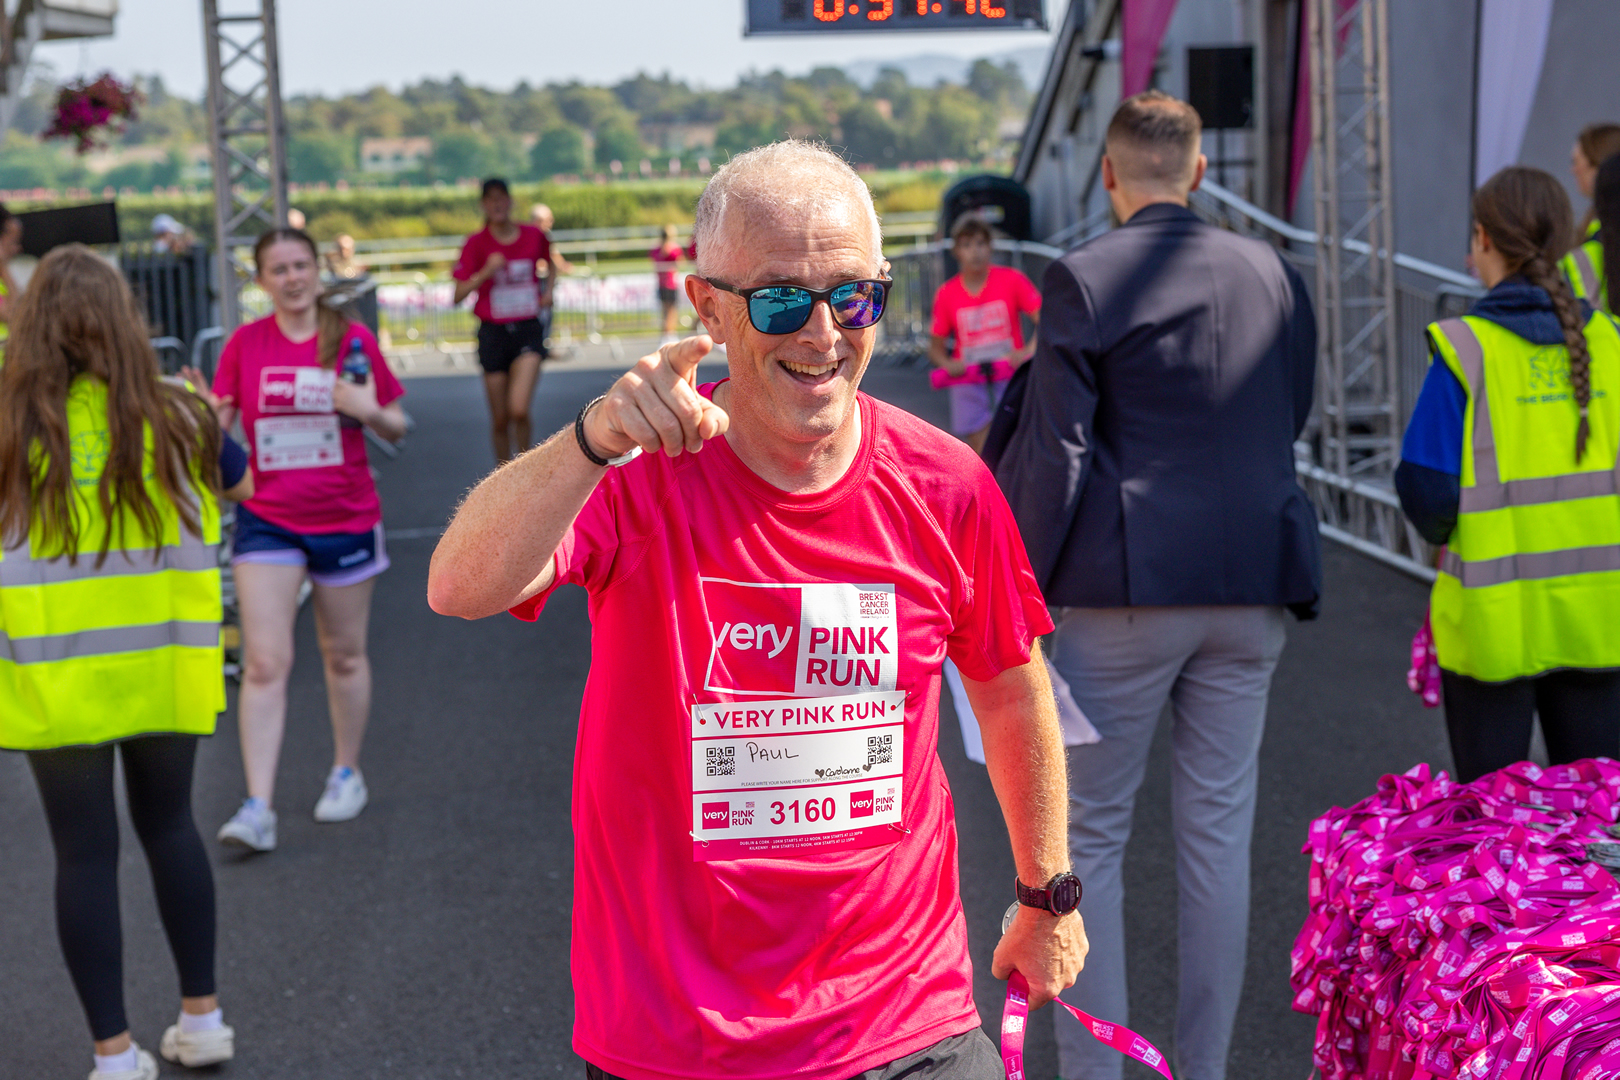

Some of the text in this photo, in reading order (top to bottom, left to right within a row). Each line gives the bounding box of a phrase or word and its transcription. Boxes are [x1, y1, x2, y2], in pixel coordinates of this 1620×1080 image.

[711, 622, 890, 659] very PINK
[806, 658, 881, 687] RUN
[714, 700, 885, 729] VERY PINK RUN
[746, 741, 799, 762] PAUL
[704, 796, 895, 825] very PINK 3160 very PINK
[875, 804, 892, 813] RUN
[732, 818, 752, 826] RUN
[1133, 1043, 1147, 1054] very
